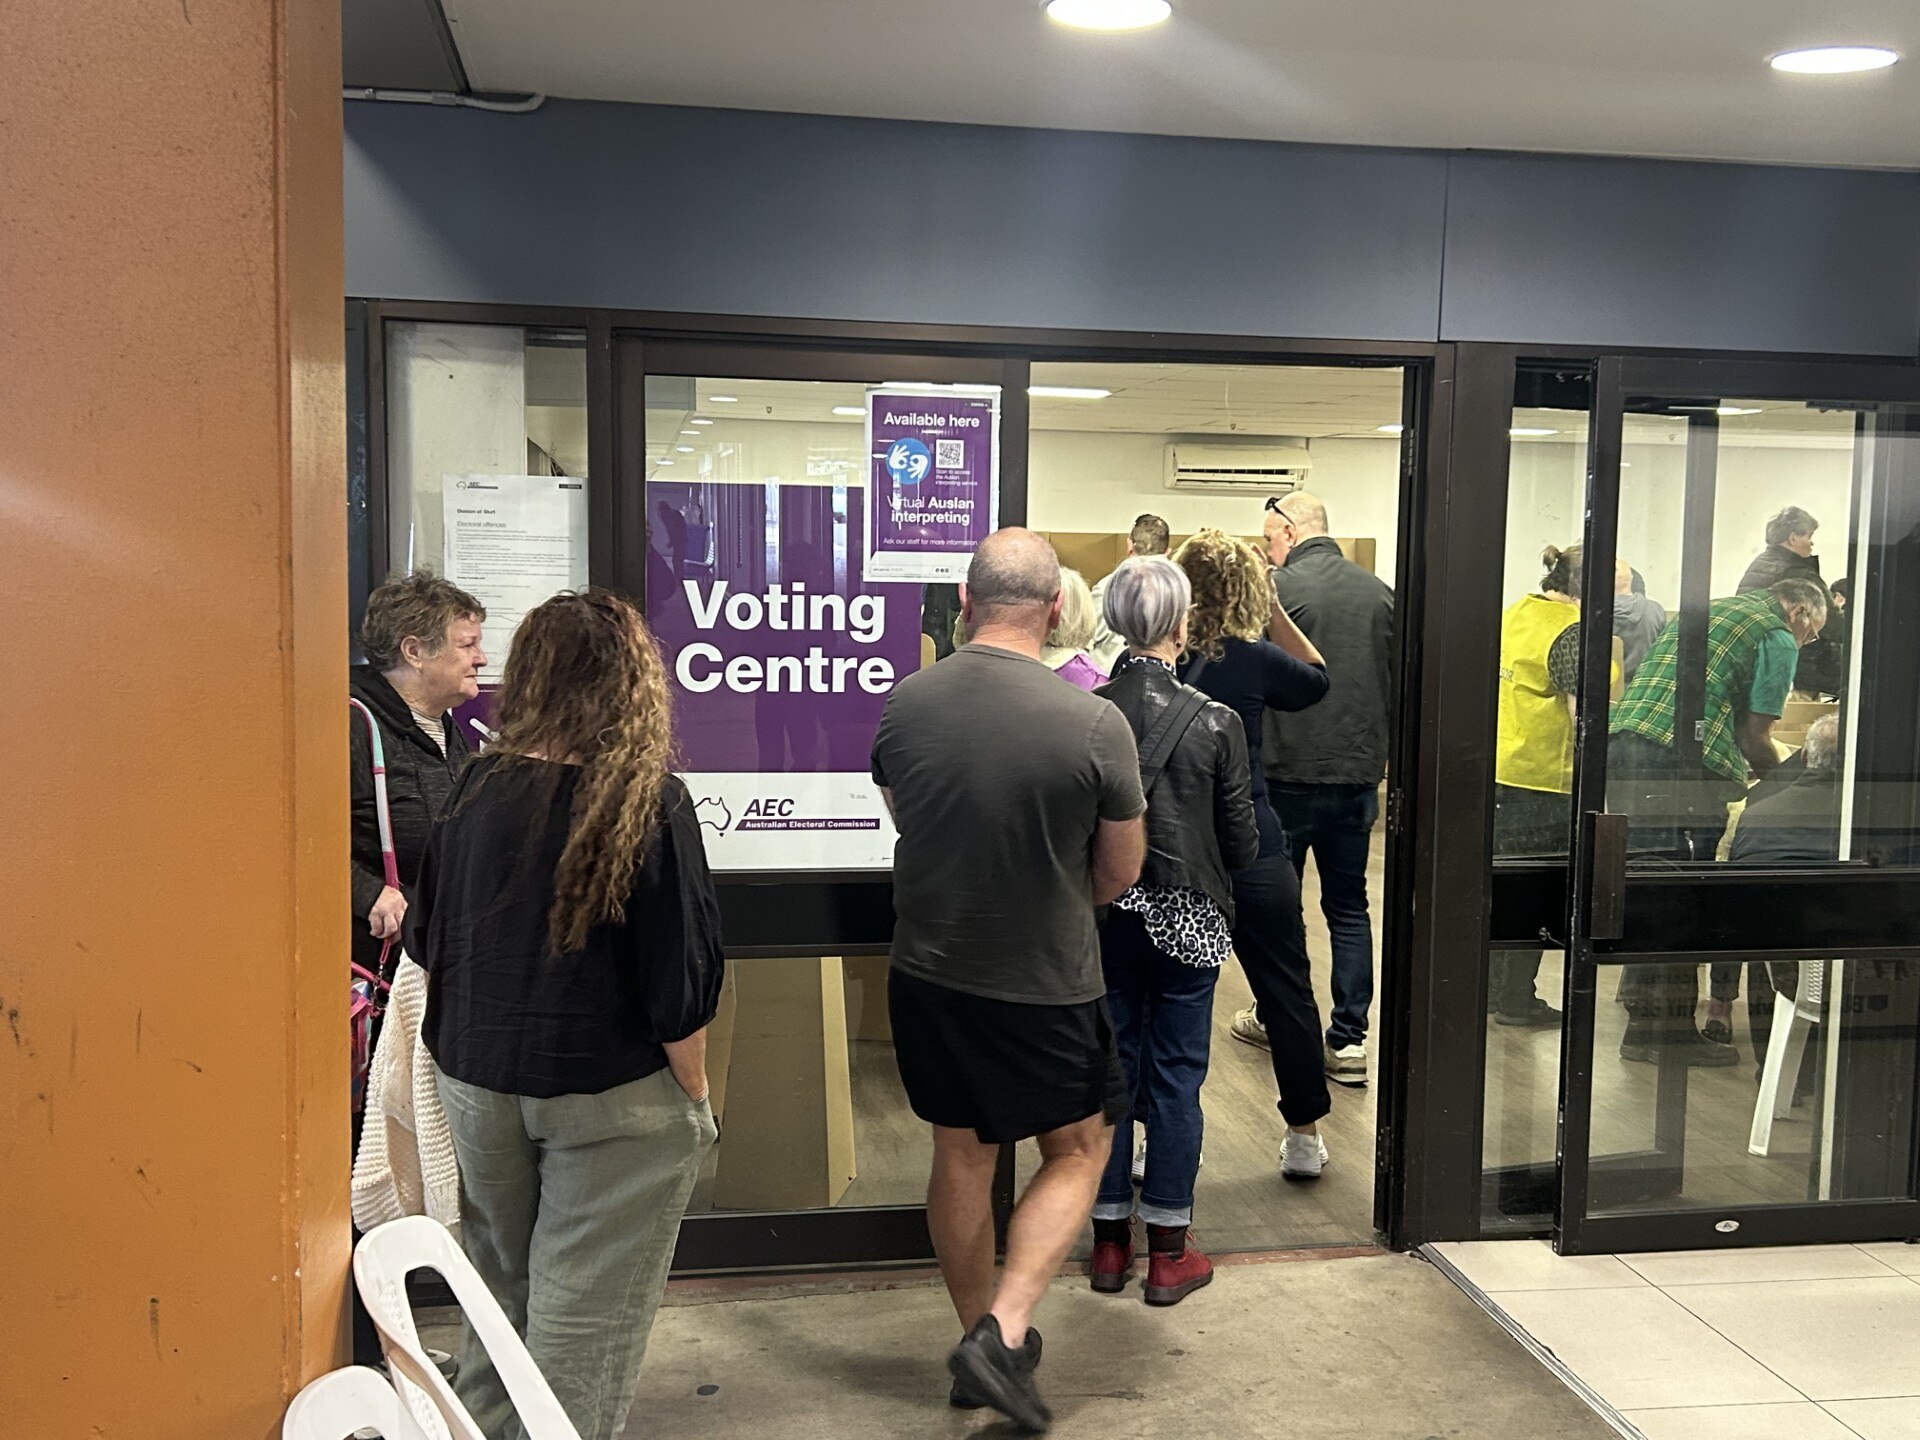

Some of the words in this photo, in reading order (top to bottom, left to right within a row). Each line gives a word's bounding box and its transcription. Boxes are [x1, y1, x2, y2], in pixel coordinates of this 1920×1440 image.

[883, 411, 946, 427] Available
[948, 413, 980, 428] here
[928, 496, 975, 510] Auslan
[891, 510, 970, 527] interpreting
[682, 579, 886, 644] Voting
[675, 642, 895, 694] Centre
[743, 798, 795, 817] AEC
[745, 820, 787, 829] Australian
[789, 820, 826, 828] Electoral
[827, 820, 876, 828] Commission
